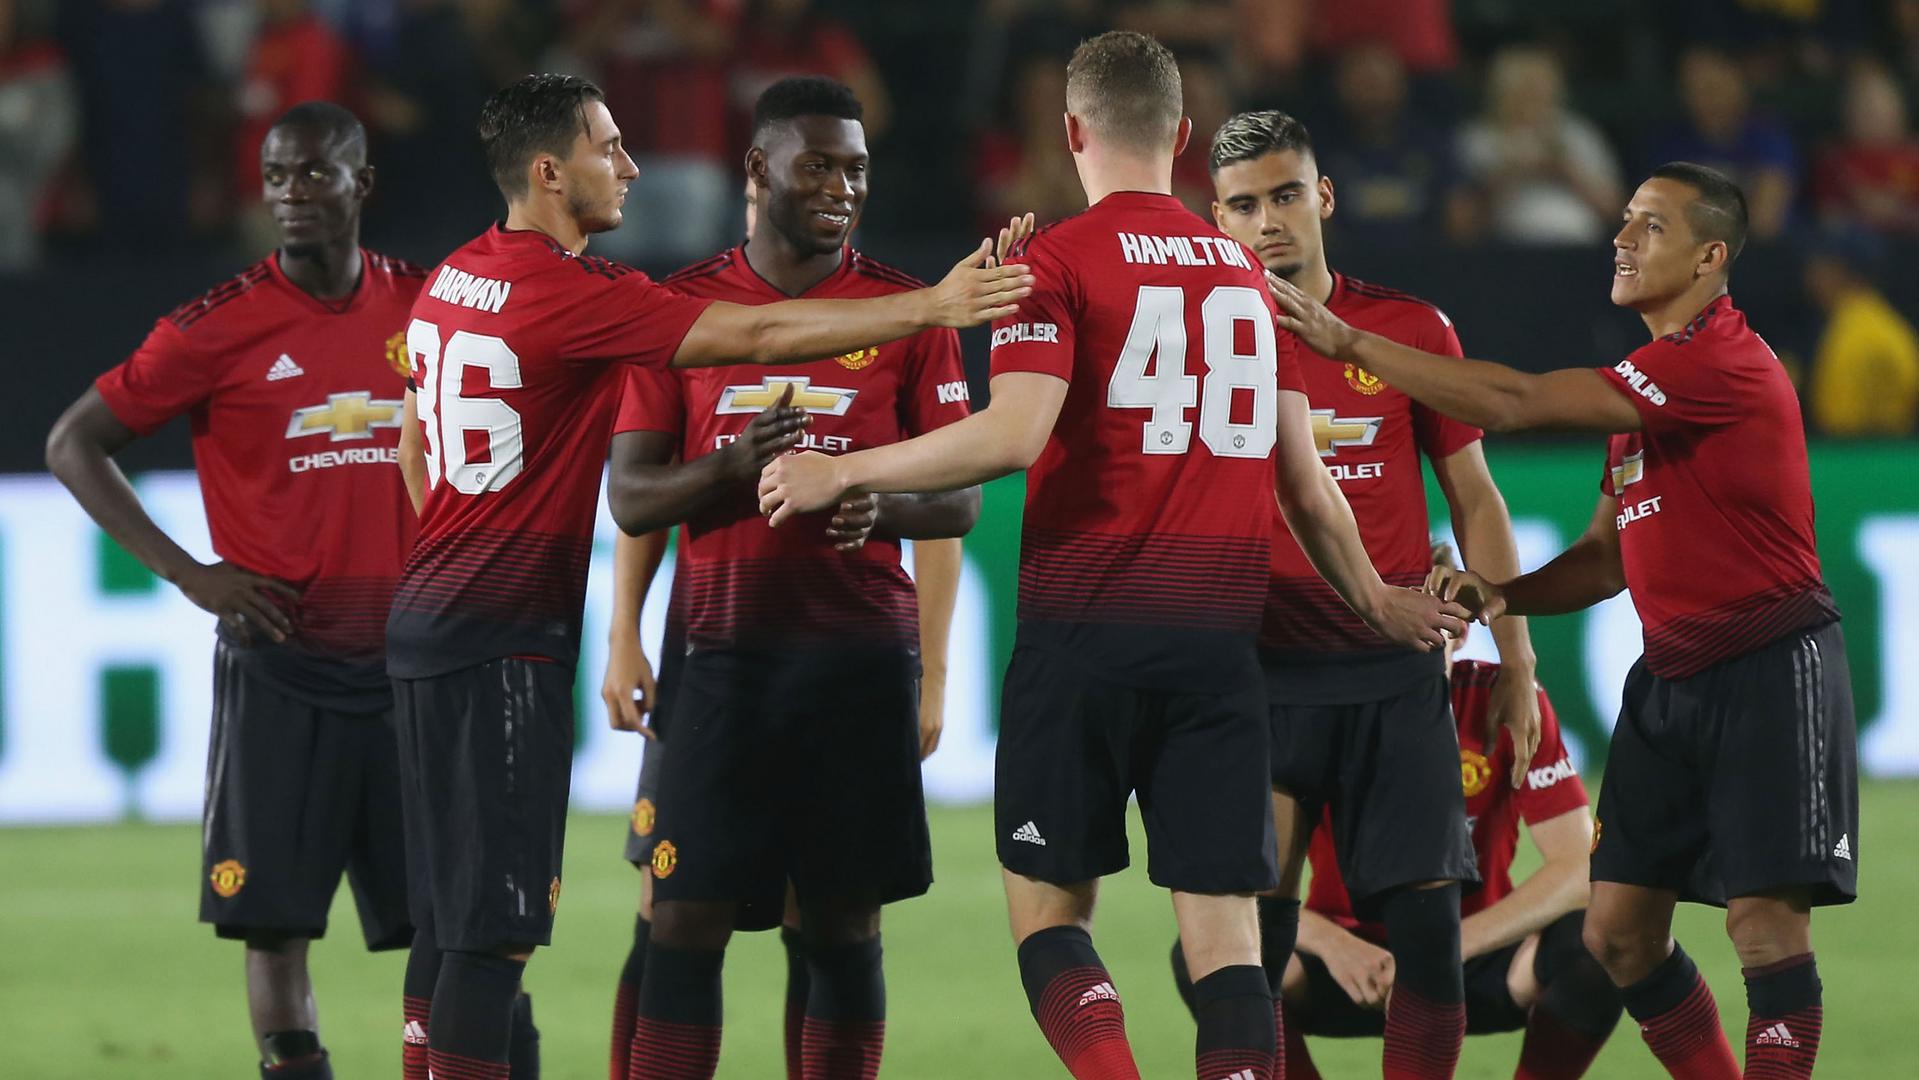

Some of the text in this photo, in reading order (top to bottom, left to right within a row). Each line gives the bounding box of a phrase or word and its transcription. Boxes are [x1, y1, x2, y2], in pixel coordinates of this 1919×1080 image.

[1117, 232, 1253, 271] HAMILTON
[990, 322, 1059, 352] KOHLER
[1107, 285, 1278, 459] 48
[936, 380, 970, 404] KOH
[289, 447, 400, 473] CHEVROLE
[1012, 832, 1046, 846] adidas
[1756, 1035, 1800, 1048] adidas
